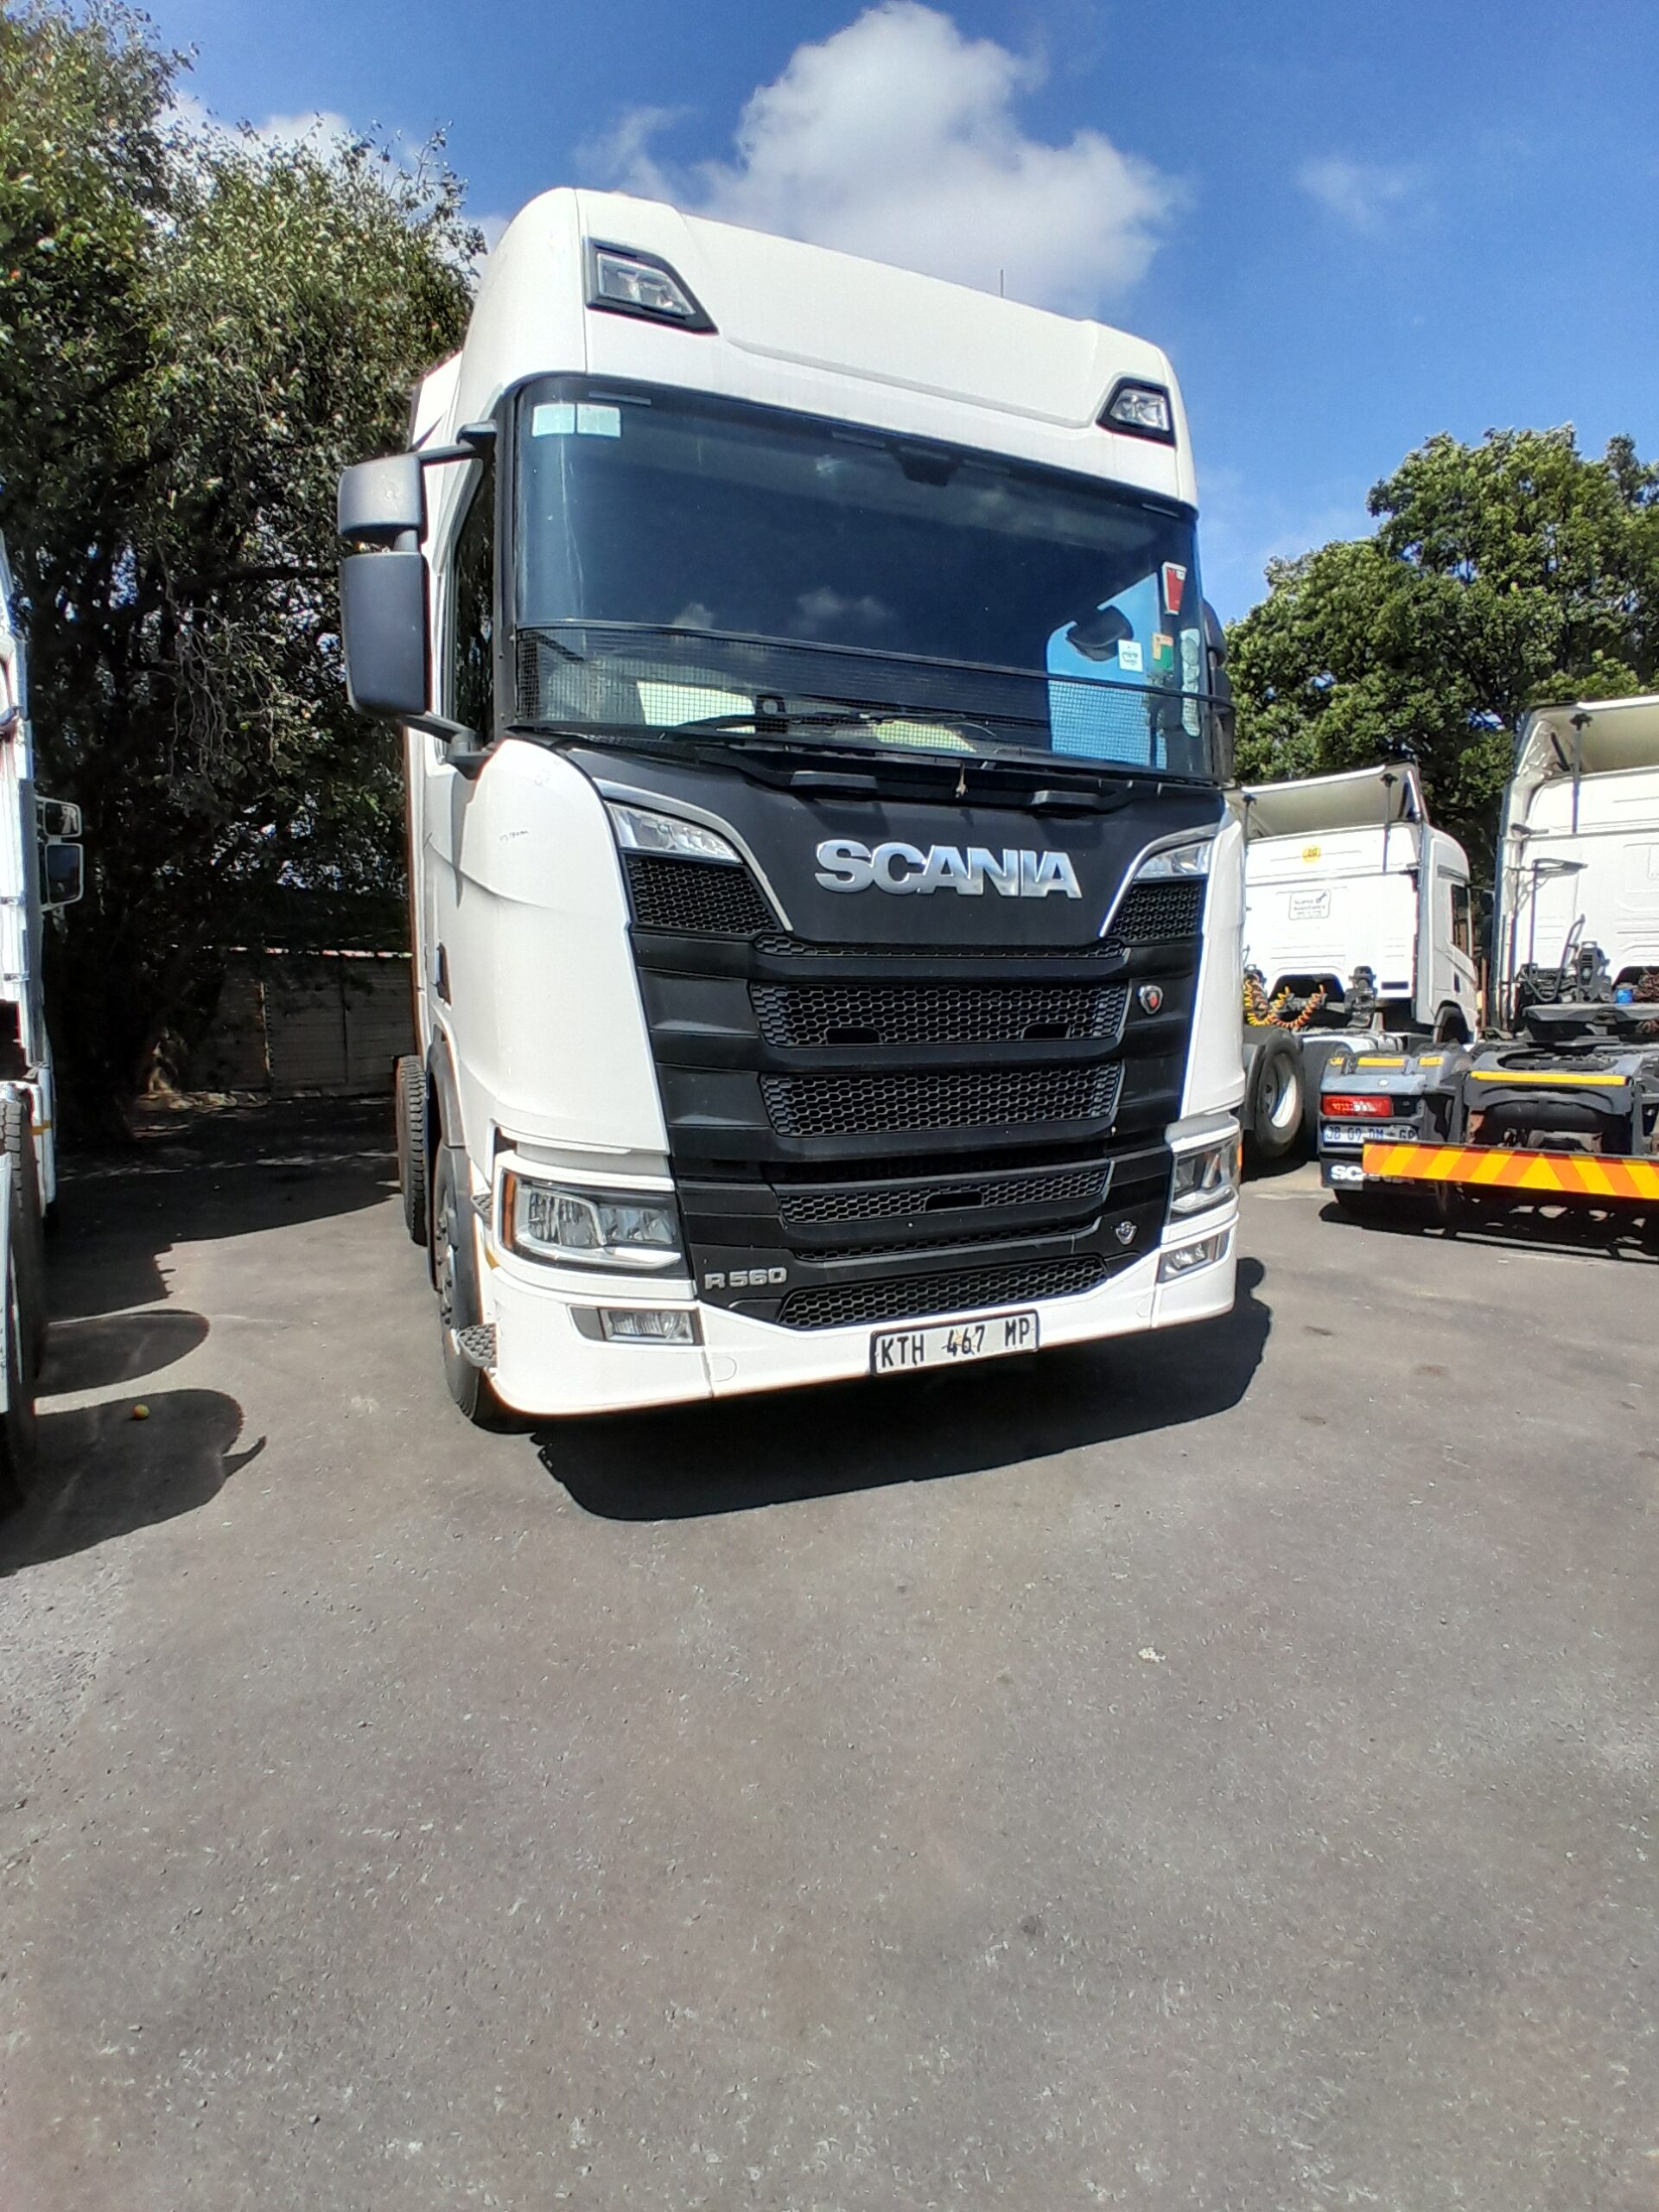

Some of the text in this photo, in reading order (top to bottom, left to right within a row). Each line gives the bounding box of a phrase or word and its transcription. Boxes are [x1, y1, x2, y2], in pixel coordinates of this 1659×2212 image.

[814, 839, 1083, 899] SCANIA
[881, 1317, 1030, 1368] KTH 467 MP
